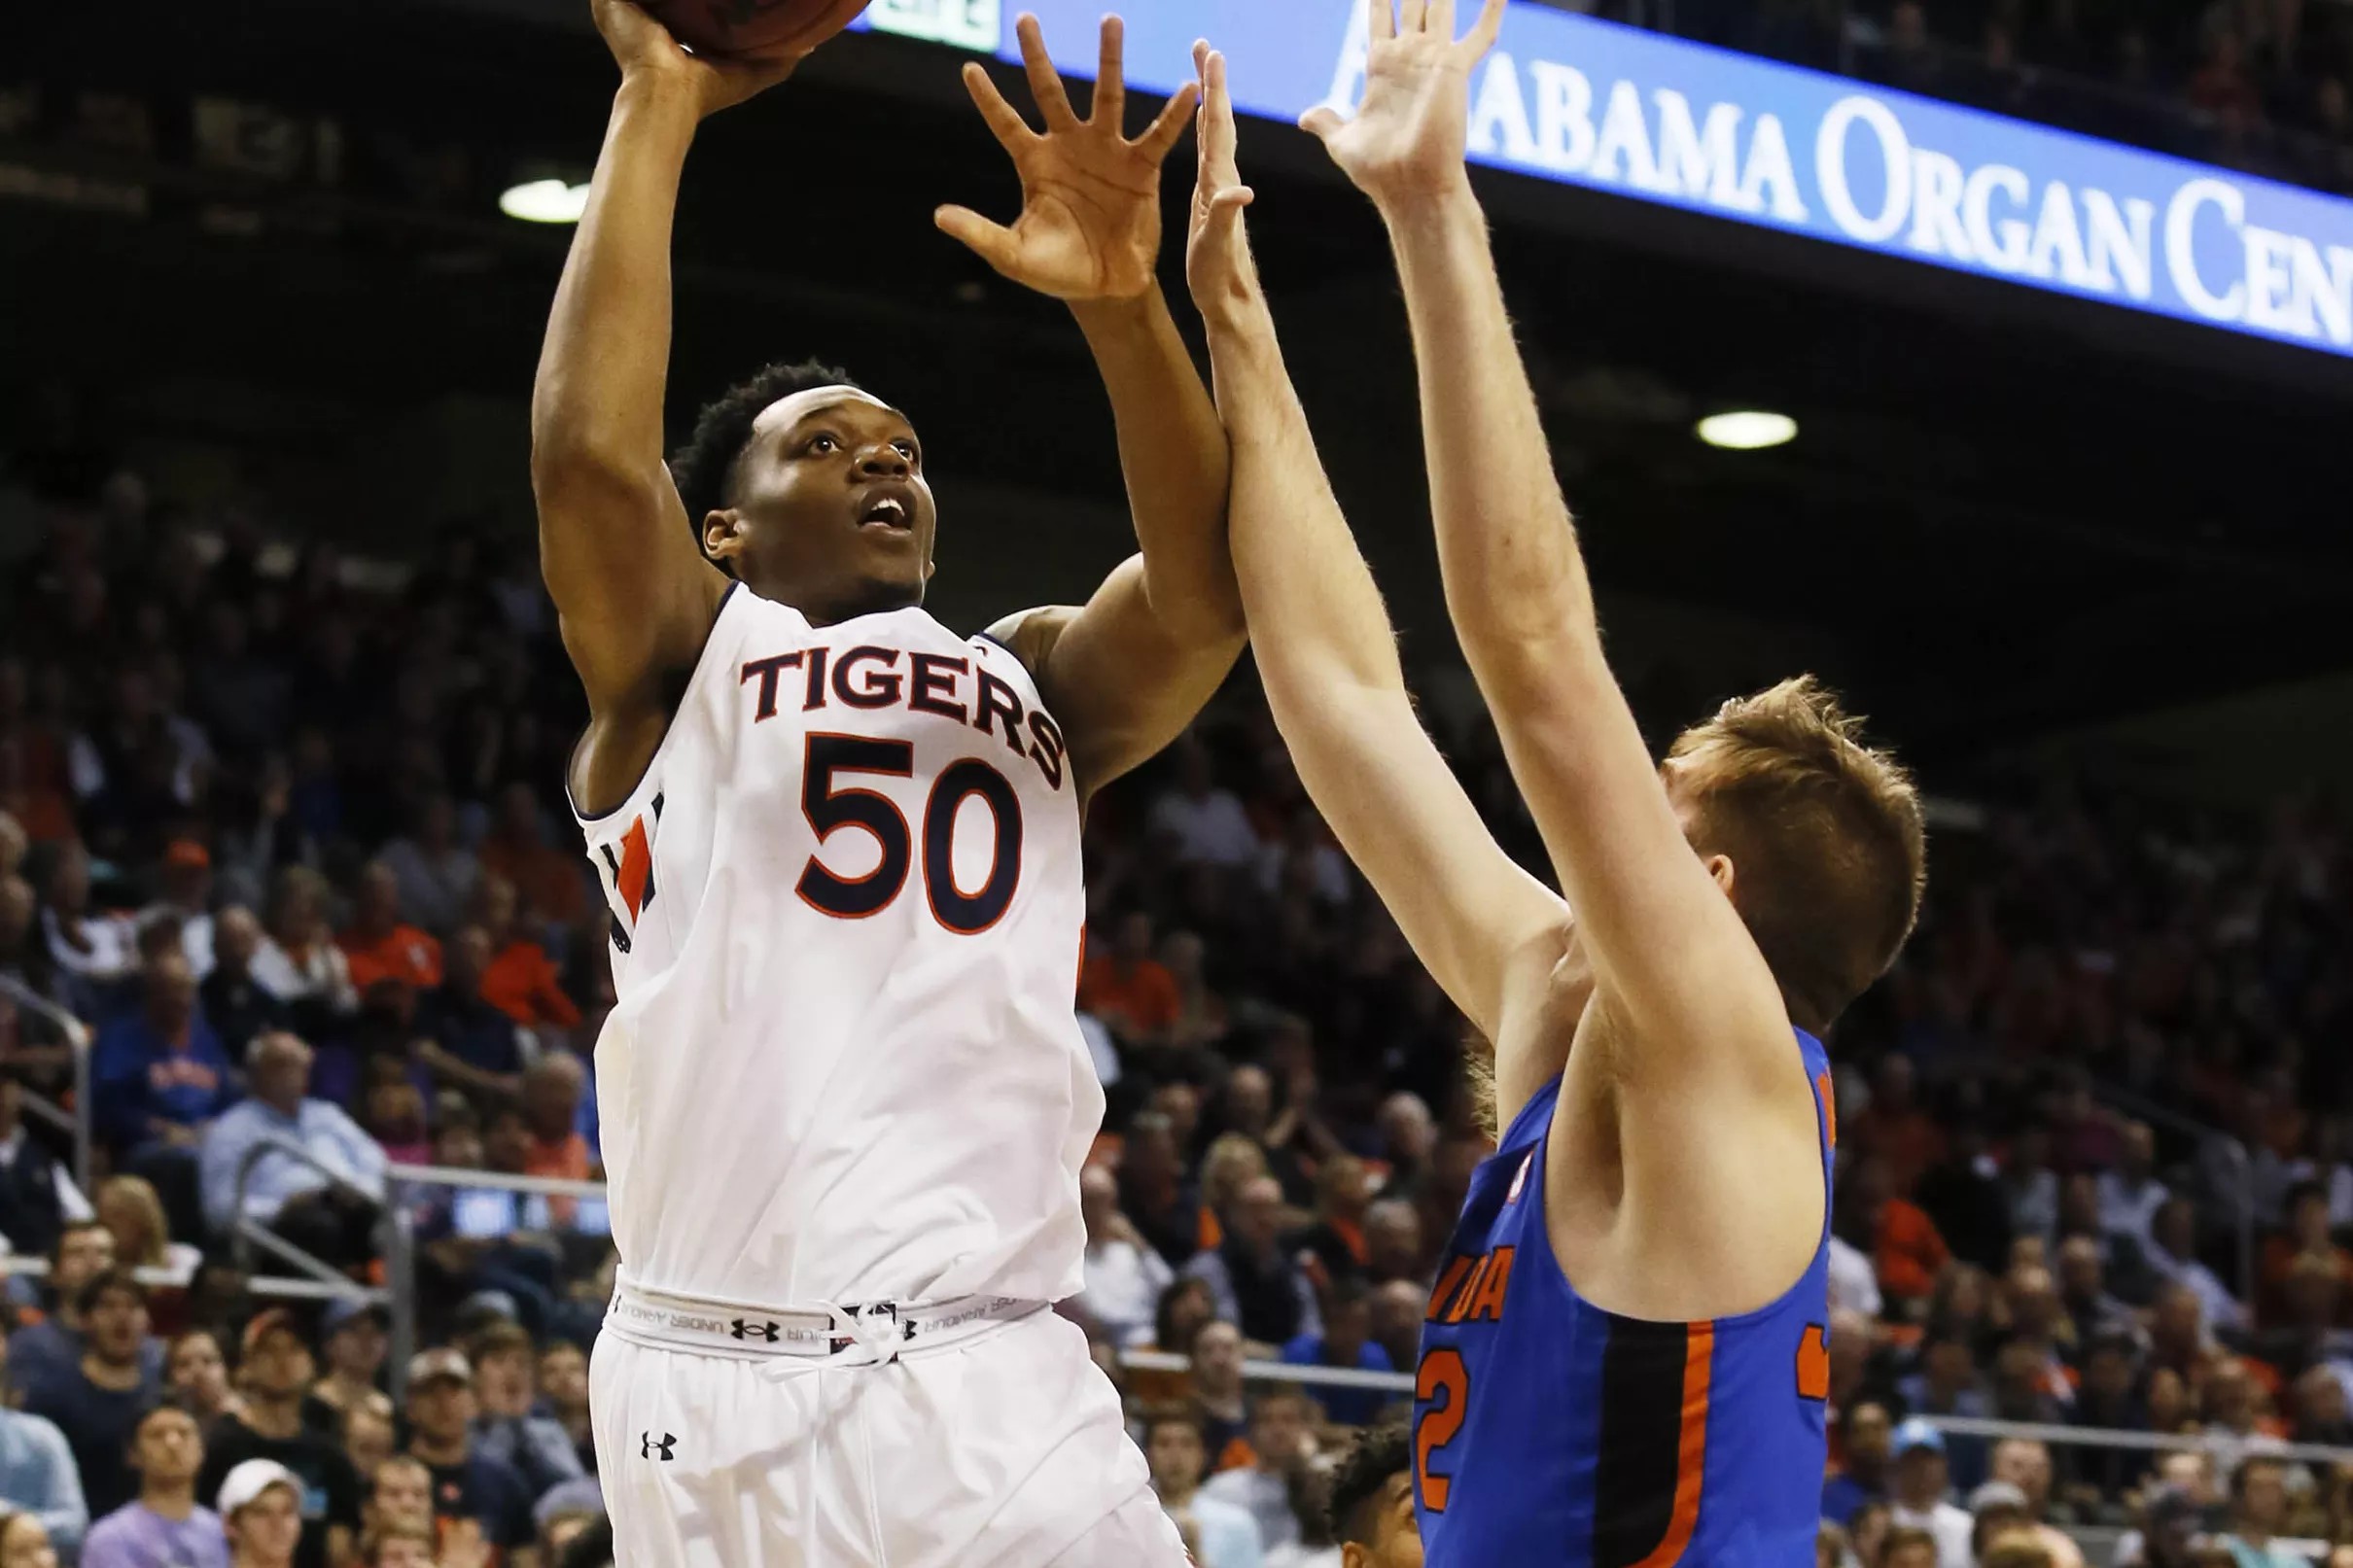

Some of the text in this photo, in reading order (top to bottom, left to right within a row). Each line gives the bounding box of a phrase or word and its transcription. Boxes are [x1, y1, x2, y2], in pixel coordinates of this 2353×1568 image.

[1317, 0, 1809, 223] ABAMA
[1815, 95, 2154, 300] ORGAN
[740, 645, 1065, 790] TIGERS
[795, 731, 1024, 935] 50
